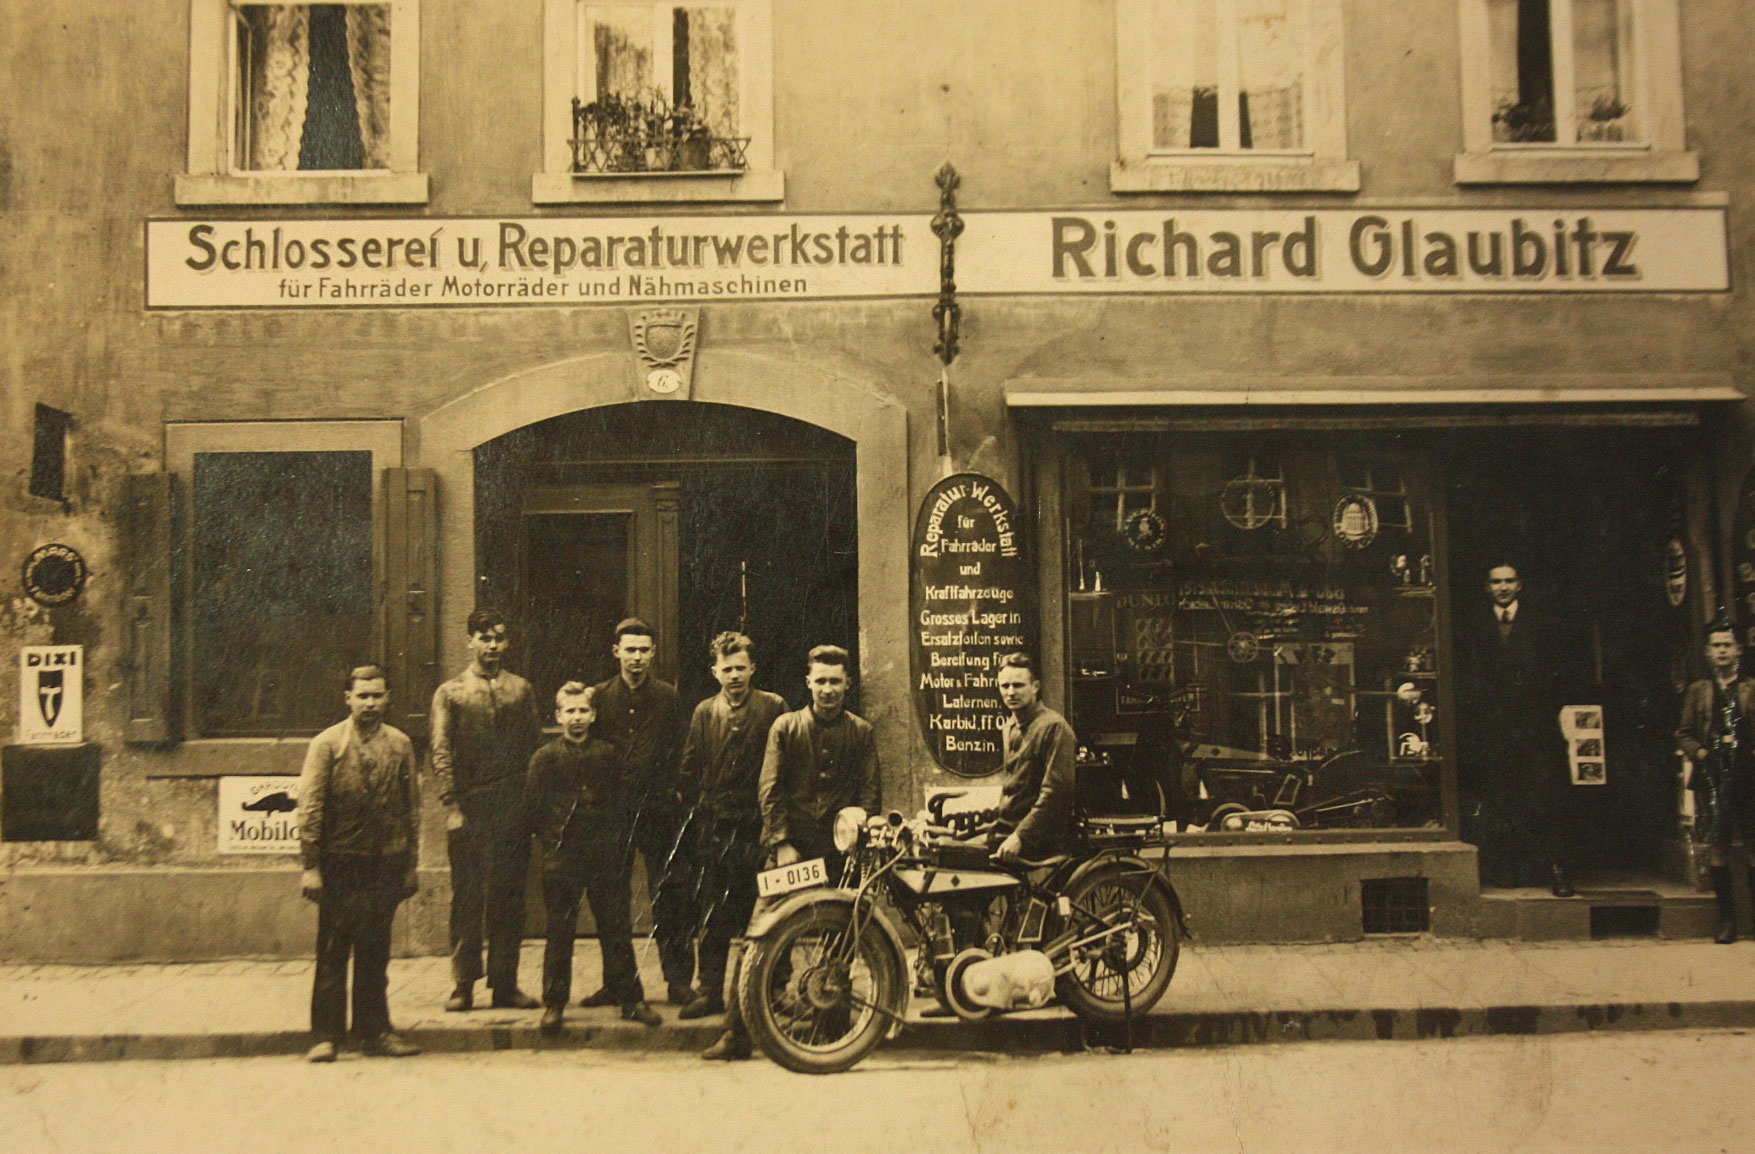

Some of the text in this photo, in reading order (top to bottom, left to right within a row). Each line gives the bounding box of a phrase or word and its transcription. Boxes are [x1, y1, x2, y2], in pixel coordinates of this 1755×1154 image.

[185, 224, 444, 272] Schlosserei
[498, 221, 904, 276] Reparaturwerkstatt
[1051, 214, 1640, 279] Richard Glaubitz
[279, 274, 807, 298] für Fahrräder Motorräder und Nähmaschinen
[957, 514, 976, 529] für
[941, 538, 997, 553] Fahrräder
[959, 561, 981, 575] und
[925, 585, 1014, 603] Kraftfahrzeuge
[920, 609, 1021, 629] Grosses Lager in
[993, 635, 1024, 645] sowie
[28, 651, 76, 667] DIXI
[931, 651, 990, 671] Bereifung
[920, 672, 954, 690] Motor
